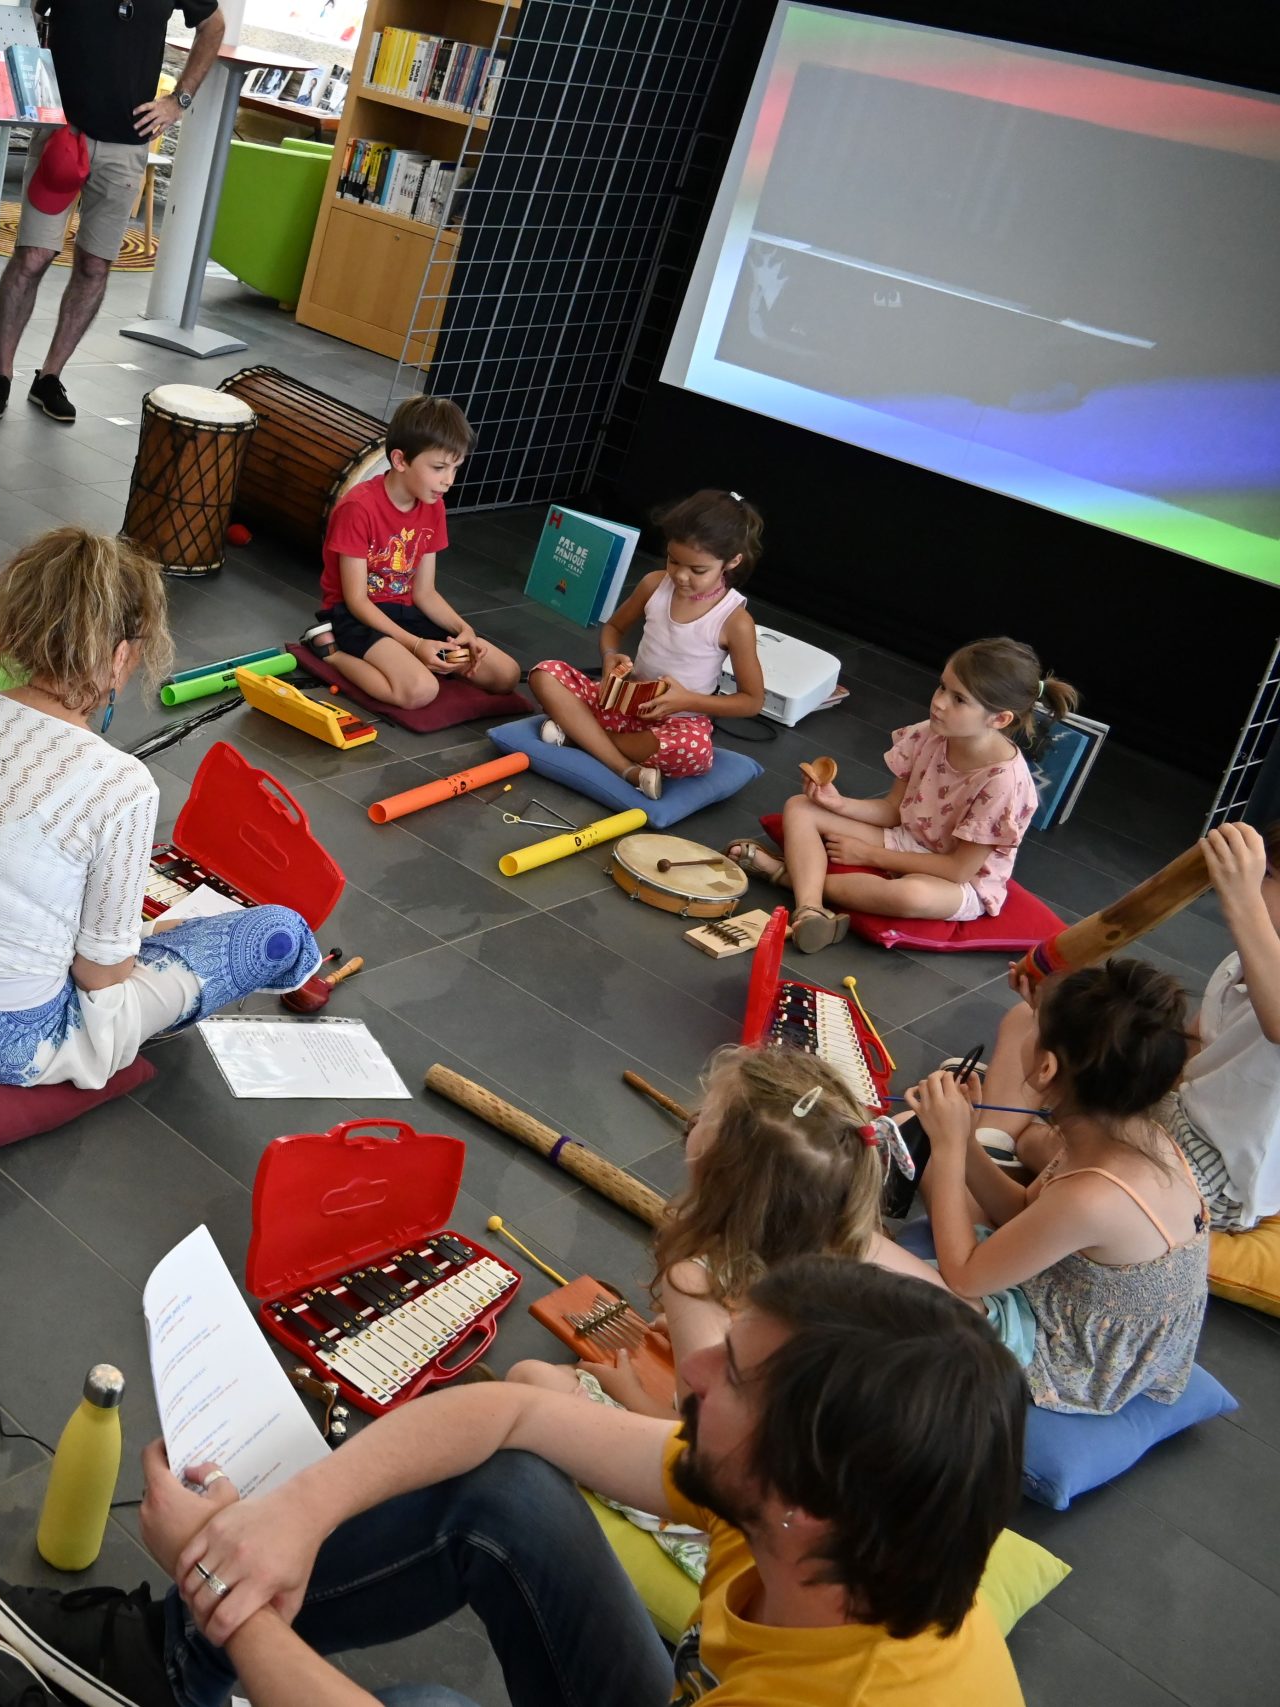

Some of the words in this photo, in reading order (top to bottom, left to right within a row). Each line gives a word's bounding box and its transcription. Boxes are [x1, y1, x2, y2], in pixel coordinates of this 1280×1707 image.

[554, 545, 585, 570] PANIQUE
[558, 536, 575, 551] PAS
[576, 545, 589, 559] DE
